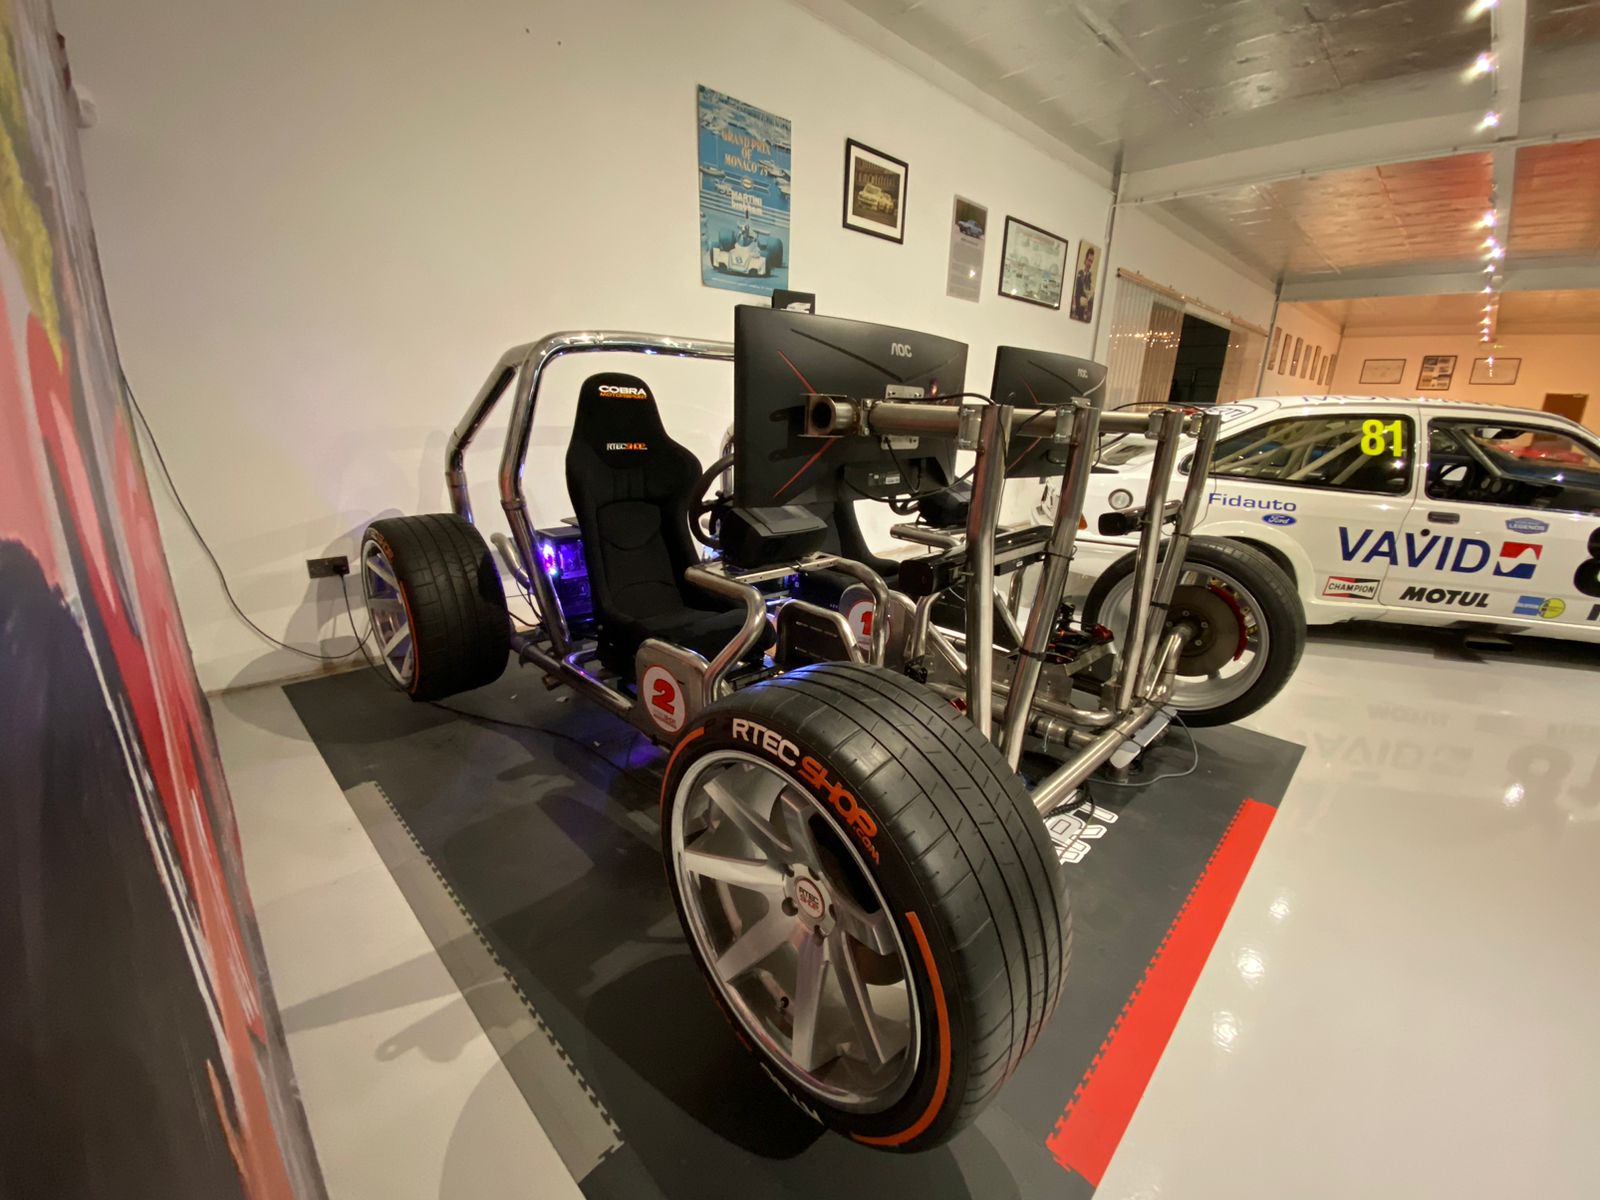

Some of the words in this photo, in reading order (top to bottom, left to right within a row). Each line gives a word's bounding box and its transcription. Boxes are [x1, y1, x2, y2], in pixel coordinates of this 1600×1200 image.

[725, 153, 757, 174] MONACO
[891, 342, 913, 358] AOC
[598, 385, 647, 396] COBRA
[1361, 419, 1402, 457] 81
[1209, 493, 1297, 512] Fidauto
[1267, 515, 1291, 525] Ford
[1339, 527, 1491, 573] VAVID
[1328, 582, 1375, 594] CHAMPION
[1399, 586, 1490, 608] MOTUL
[652, 678, 676, 716] 2
[732, 718, 800, 767] RTEC
